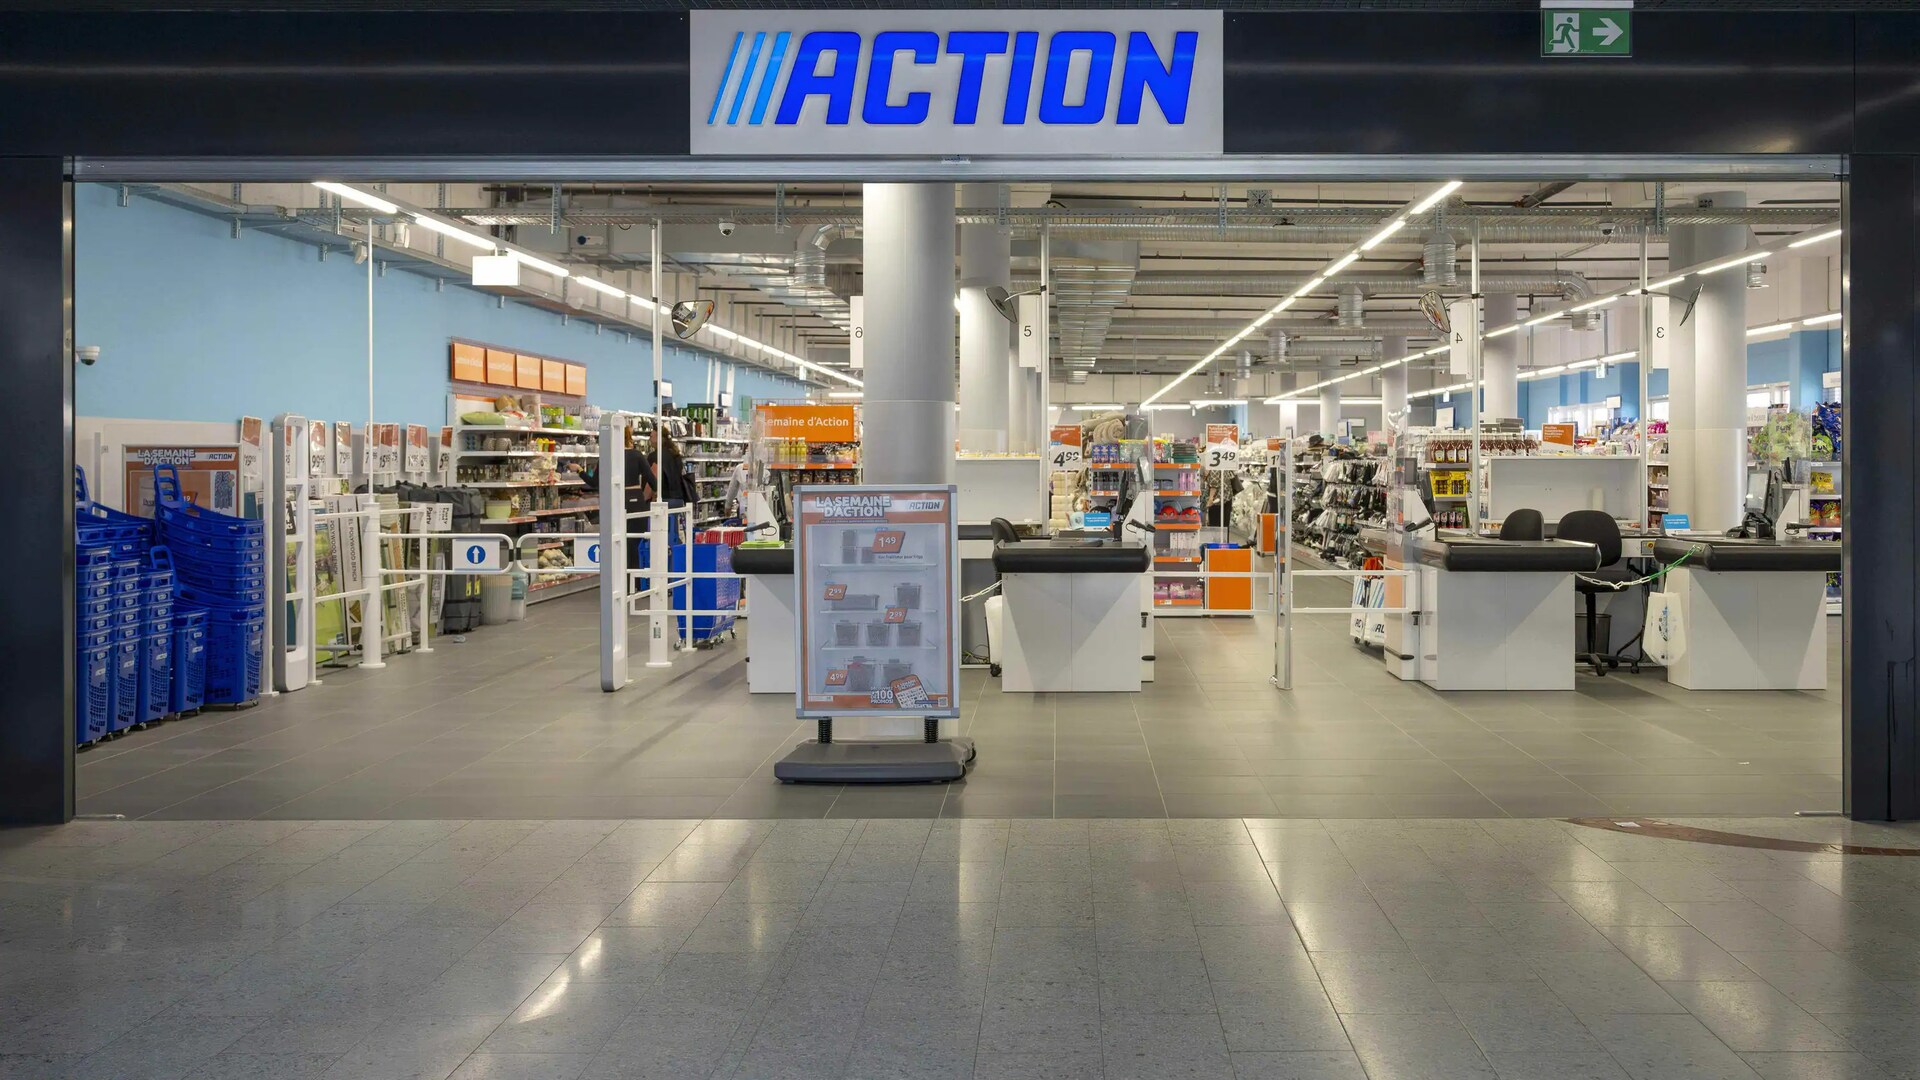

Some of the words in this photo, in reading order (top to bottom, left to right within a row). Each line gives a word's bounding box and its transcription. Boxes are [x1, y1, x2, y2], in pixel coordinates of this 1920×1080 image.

[774, 31, 1199, 125] ACTION
[1023, 325, 1032, 337] 5
[764, 416, 805, 426] emaine
[807, 416, 849, 427] d'Action
[137, 449, 151, 458] LA
[151, 449, 196, 459] SEMAINE
[1053, 451, 1080, 467] 499
[1209, 451, 1236, 467] 349
[144, 457, 190, 465] D'ACTION
[816, 496, 834, 507] LA
[834, 495, 892, 507] SEMAINE
[909, 501, 940, 509] ACTION
[824, 506, 884, 517] D'ACTION
[878, 536, 897, 547] 149
[828, 588, 841, 596] 299
[889, 611, 902, 619] 299
[830, 673, 844, 681] 499
[876, 690, 894, 700] 100
